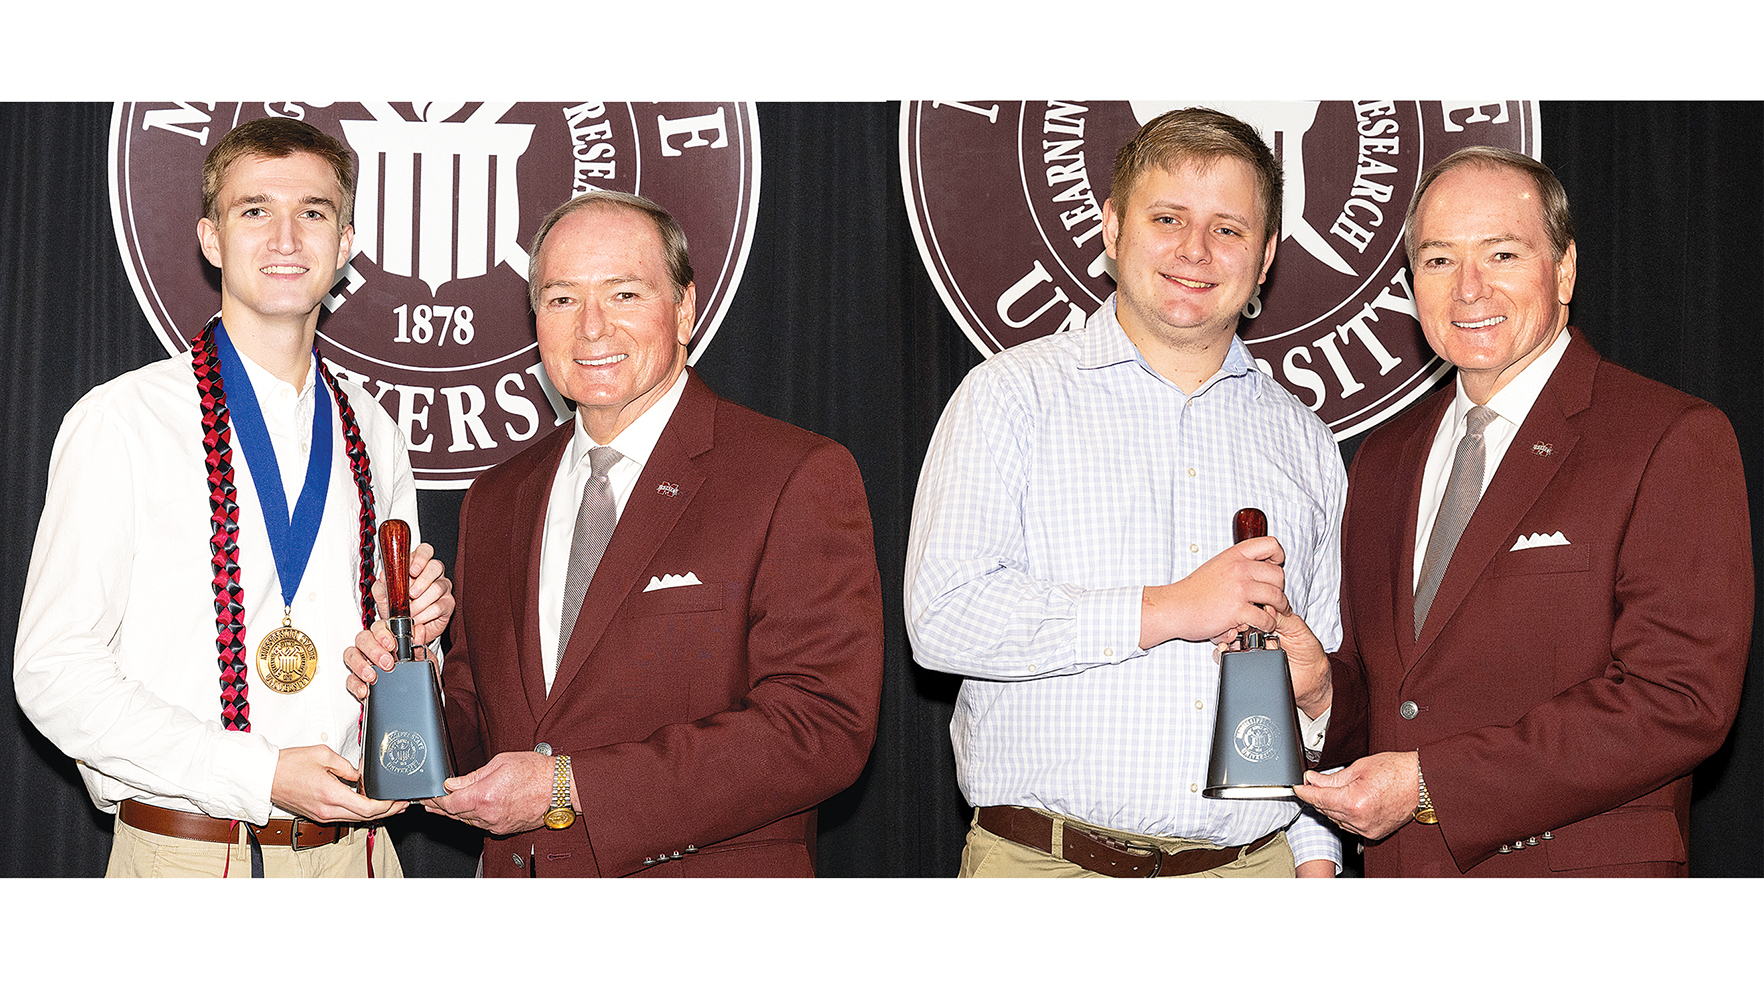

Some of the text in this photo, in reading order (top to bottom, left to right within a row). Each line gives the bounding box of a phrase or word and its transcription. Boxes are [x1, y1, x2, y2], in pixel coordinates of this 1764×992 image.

[563, 102, 616, 200] RESEA
[1042, 101, 1104, 249] LEARNIN
[1329, 101, 1400, 254] ESEARCH
[392, 303, 475, 347] 1878
